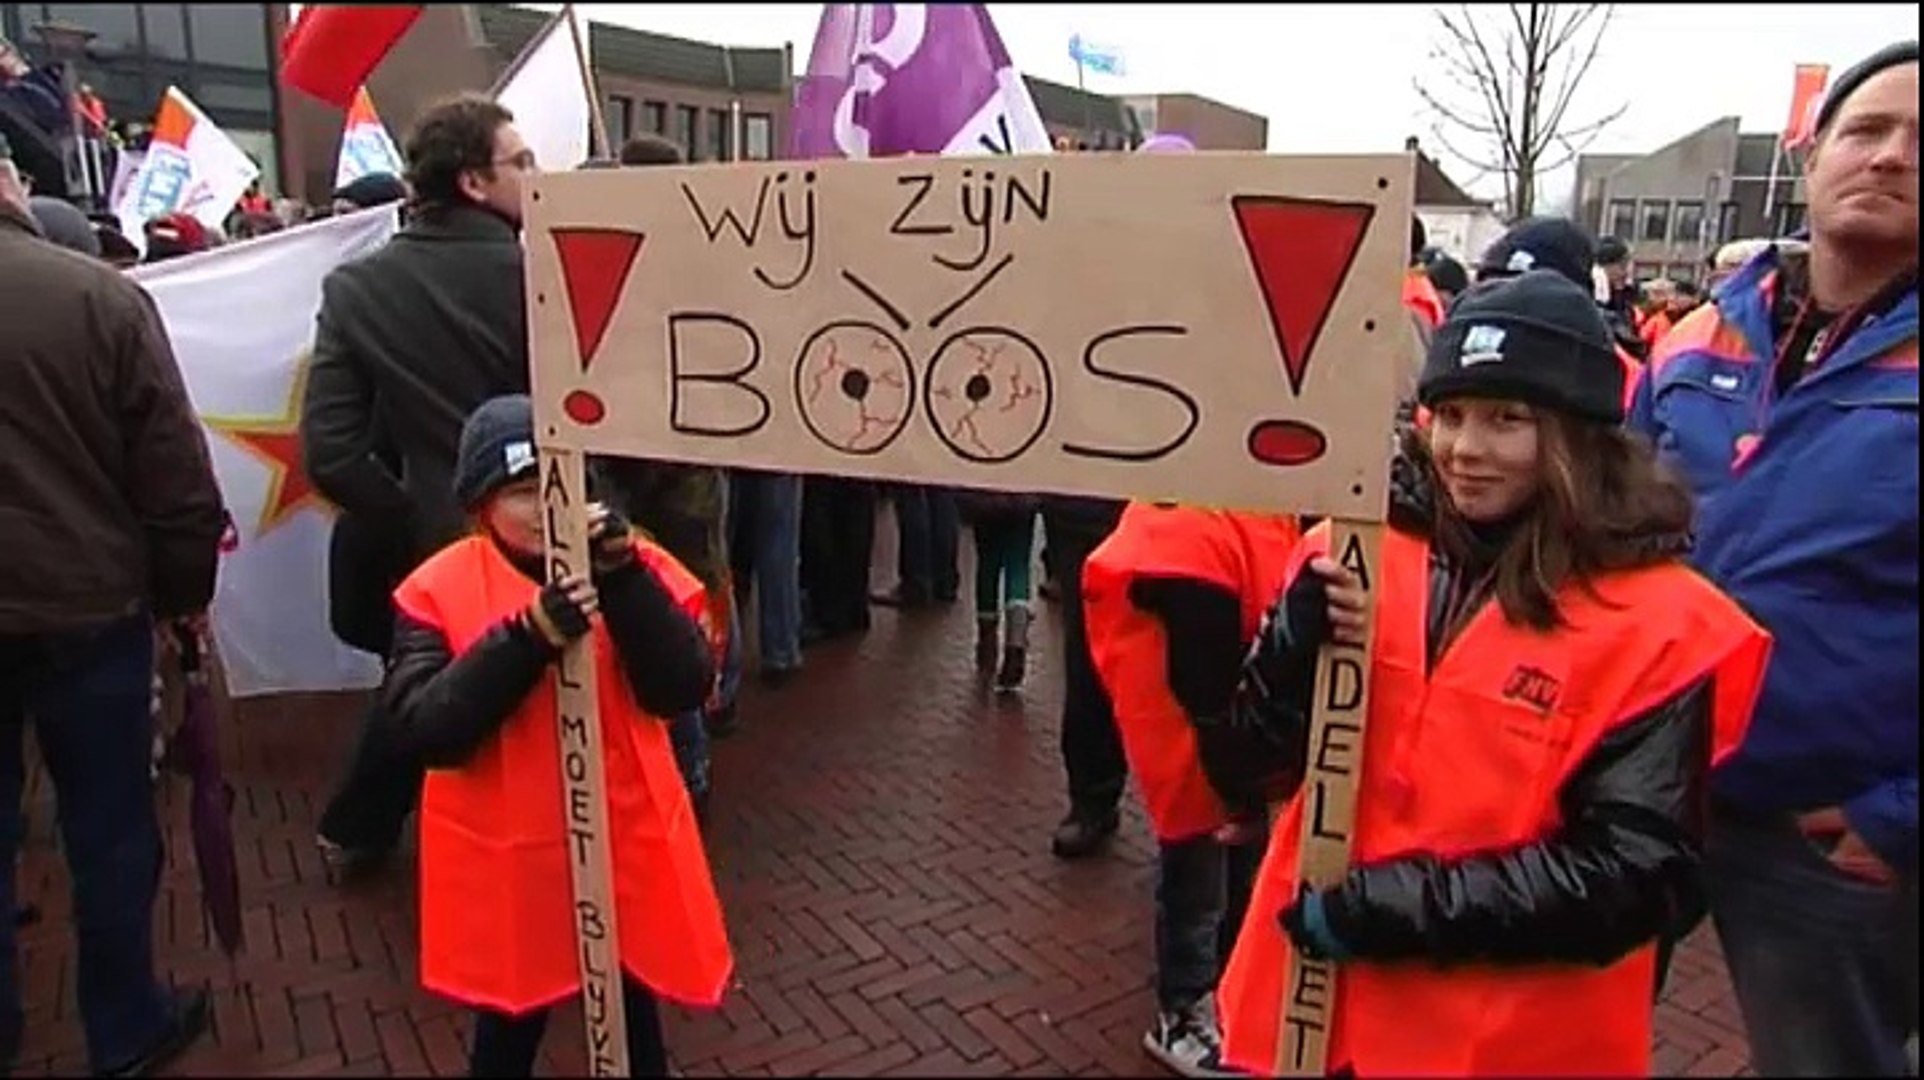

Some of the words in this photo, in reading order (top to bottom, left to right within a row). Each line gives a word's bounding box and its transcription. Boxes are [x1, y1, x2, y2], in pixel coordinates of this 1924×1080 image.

[668, 311, 1200, 466] BOOS
[1311, 533, 1370, 841] ADEL
[561, 713, 594, 867] MOET
